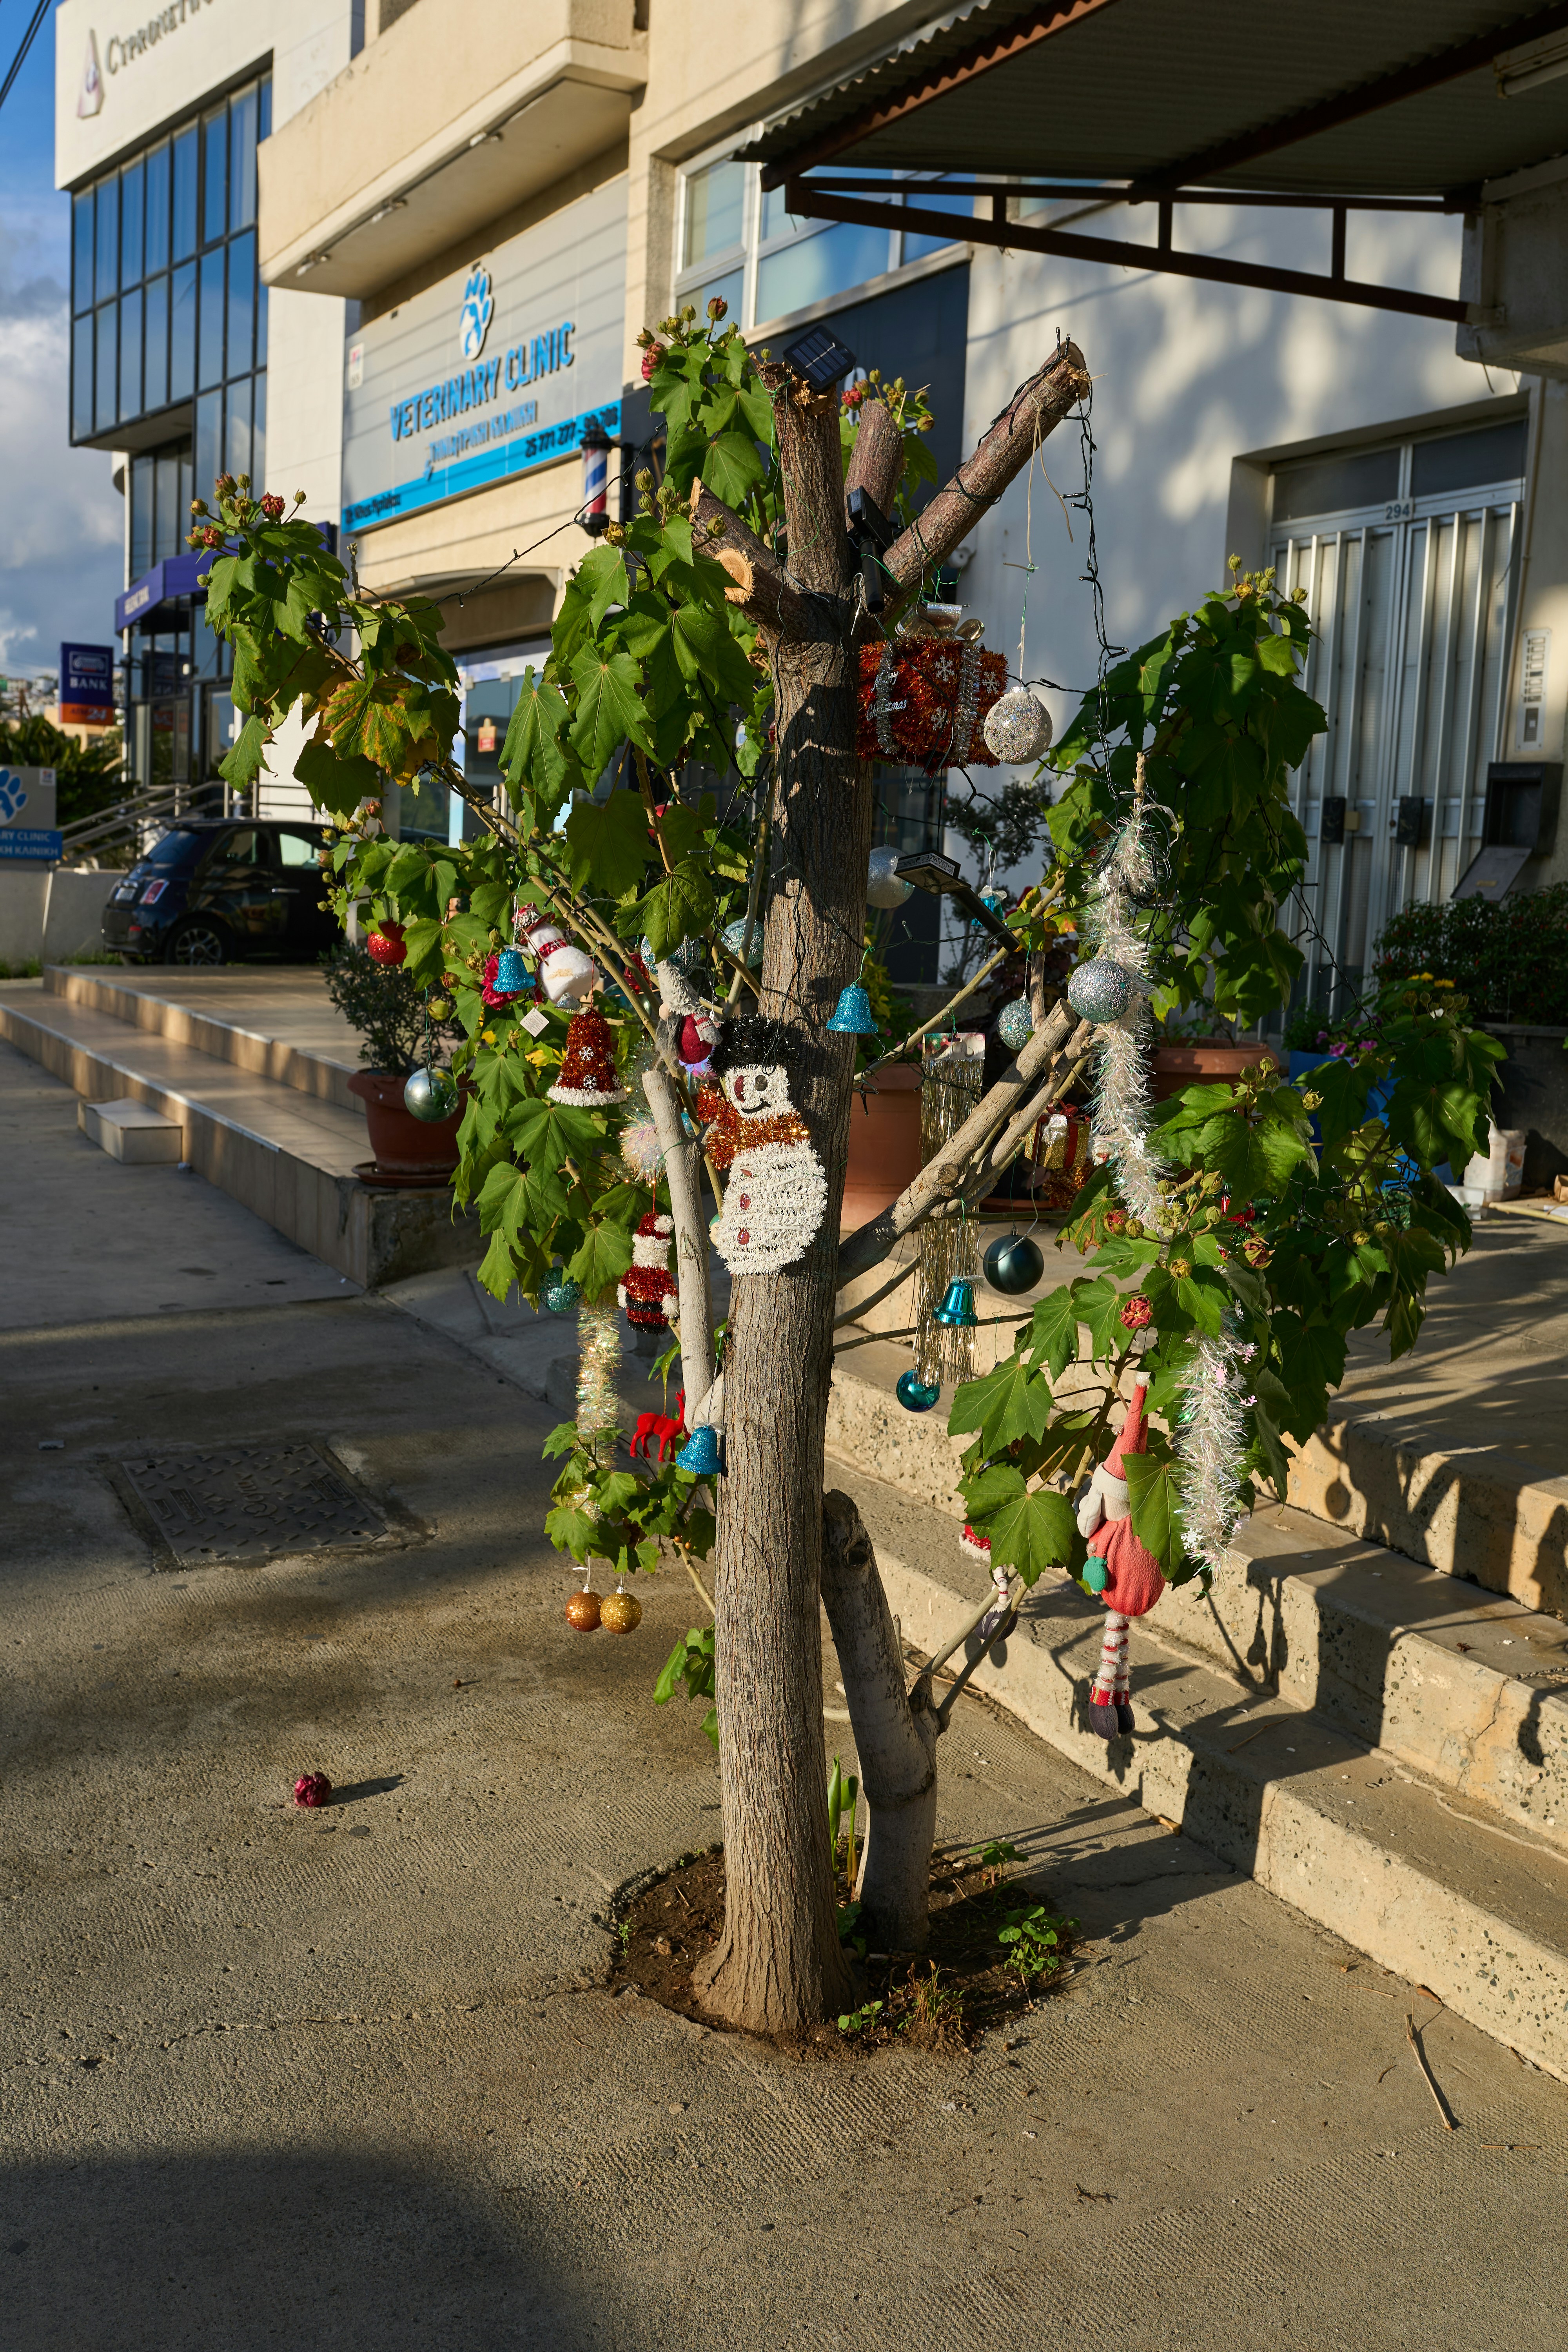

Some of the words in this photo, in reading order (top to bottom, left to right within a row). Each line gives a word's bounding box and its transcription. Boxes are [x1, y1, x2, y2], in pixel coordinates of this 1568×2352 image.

[390, 356, 500, 441] VETERINARY
[505, 321, 574, 392] CLINIC
[1386, 503, 1410, 520] 294
[70, 676, 108, 691] BANK
[86, 707, 107, 721] 24
[17, 831, 51, 842] CLINIC
